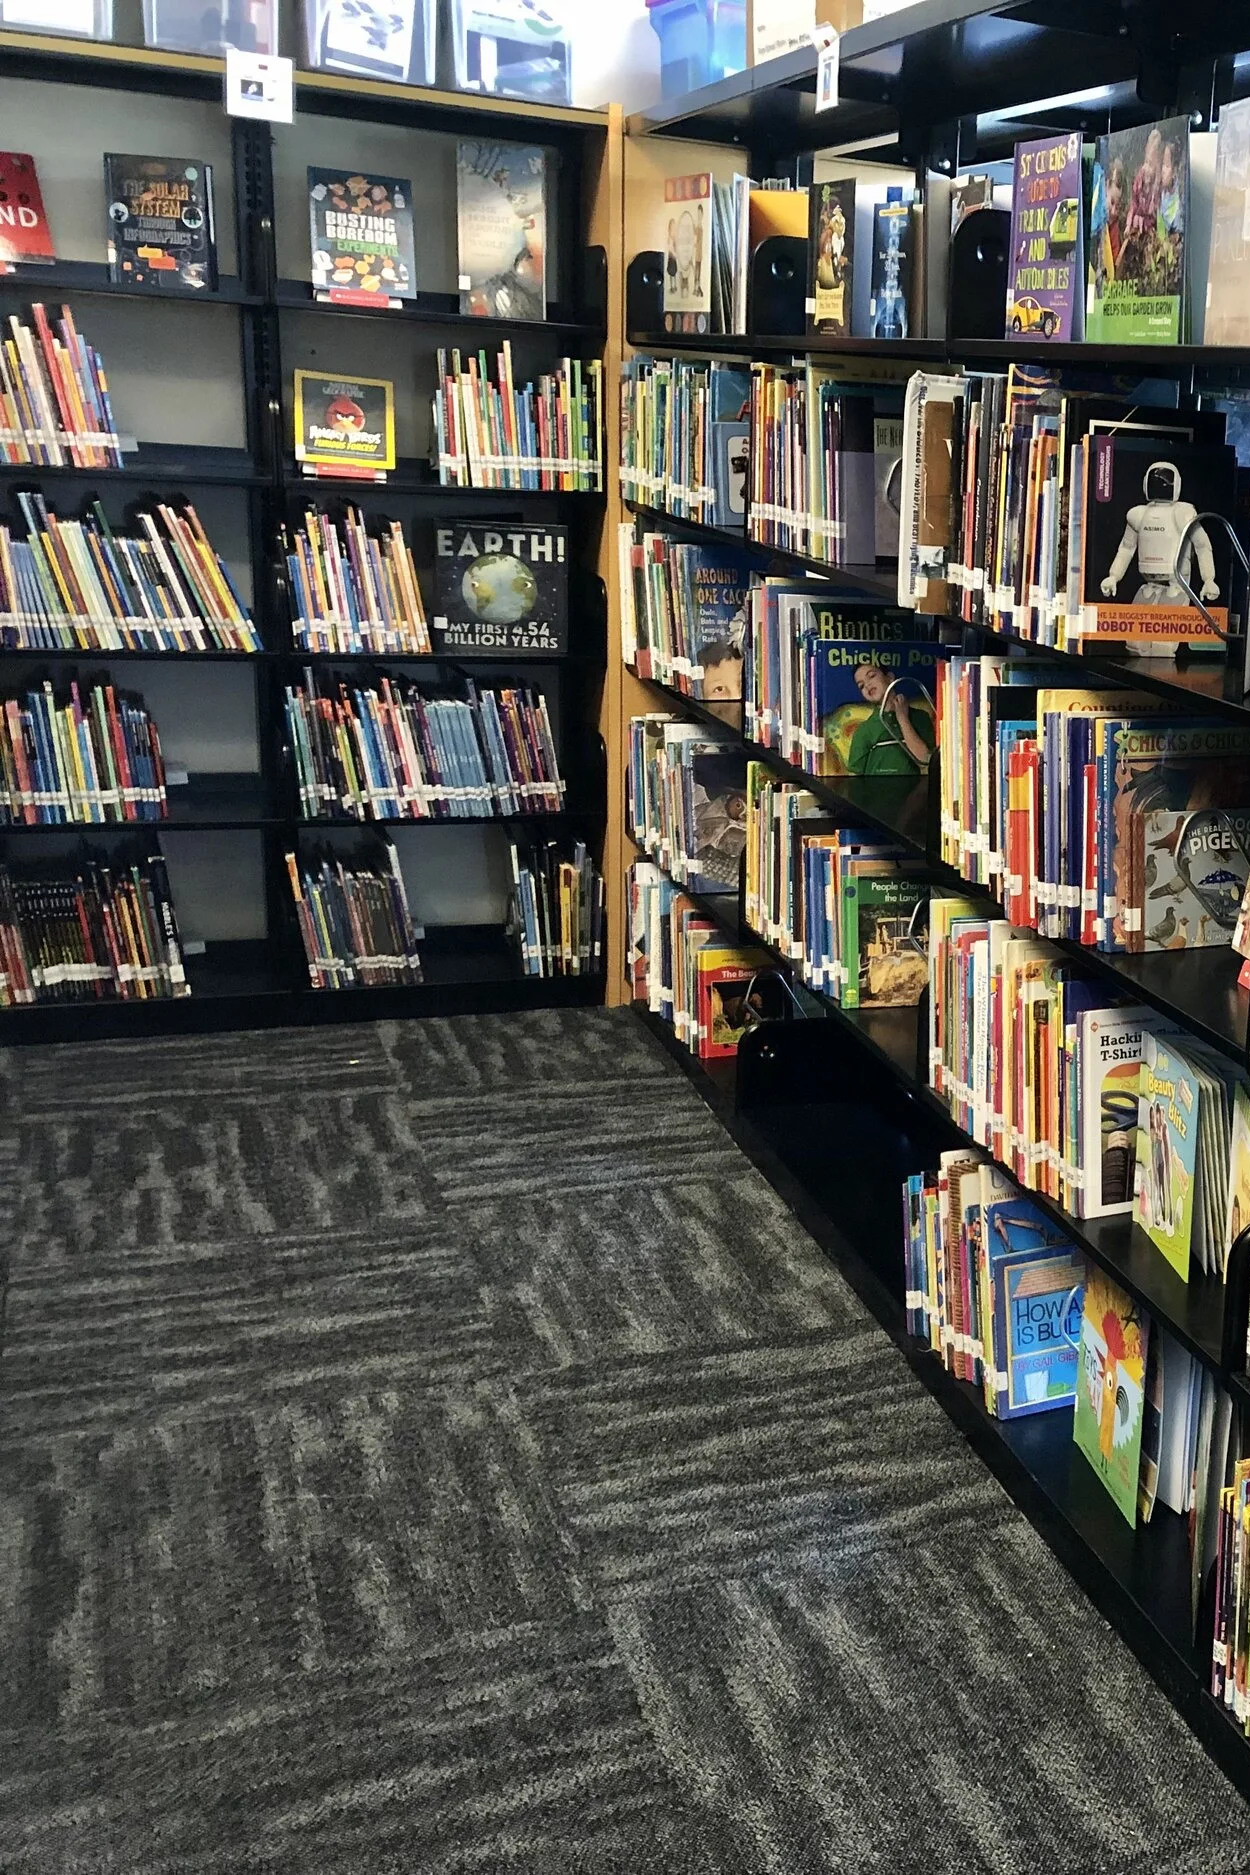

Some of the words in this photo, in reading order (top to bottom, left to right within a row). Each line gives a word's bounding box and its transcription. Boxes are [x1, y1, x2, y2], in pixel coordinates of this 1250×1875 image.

[149, 181, 189, 201] SOLAR
[131, 200, 181, 219] SYSTEM
[325, 210, 396, 233] BUSTING
[326, 224, 398, 246] BOREDOM
[1028, 237, 1046, 263] AND
[1103, 303, 1120, 317] HELPS
[1132, 302, 1155, 316] GARDEN
[1156, 301, 1173, 316] GROW
[436, 528, 565, 563] EARTH!
[696, 568, 738, 584] AROUND
[698, 588, 720, 604] ONE
[701, 618, 714, 626] Bats
[716, 617, 728, 626] and
[1118, 612, 1149, 621] BIGGEST
[449, 622, 470, 634] MY
[475, 623, 508, 635] FIRST
[512, 621, 550, 637] 4.54
[820, 612, 904, 640] Bionics
[444, 632, 507, 646] BILLION
[511, 635, 558, 649] YEARS
[702, 635, 717, 644] Rats
[828, 649, 900, 667] Chicken
[1127, 734, 1188, 753] CHICKS
[1187, 827, 1201, 839] THE
[1203, 825, 1222, 837] REAL
[871, 882, 898, 893] People
[885, 893, 898, 902] the
[900, 893, 918, 902] Land
[722, 970, 737, 979] The
[1147, 1070, 1176, 1100] Beauty
[1168, 1101, 1188, 1140] Blitz
[1016, 1296, 1061, 1327] HOW
[1016, 1325, 1035, 1346] IS
[1017, 1358, 1029, 1370] BY
[1032, 1354, 1054, 1369] GAIL
